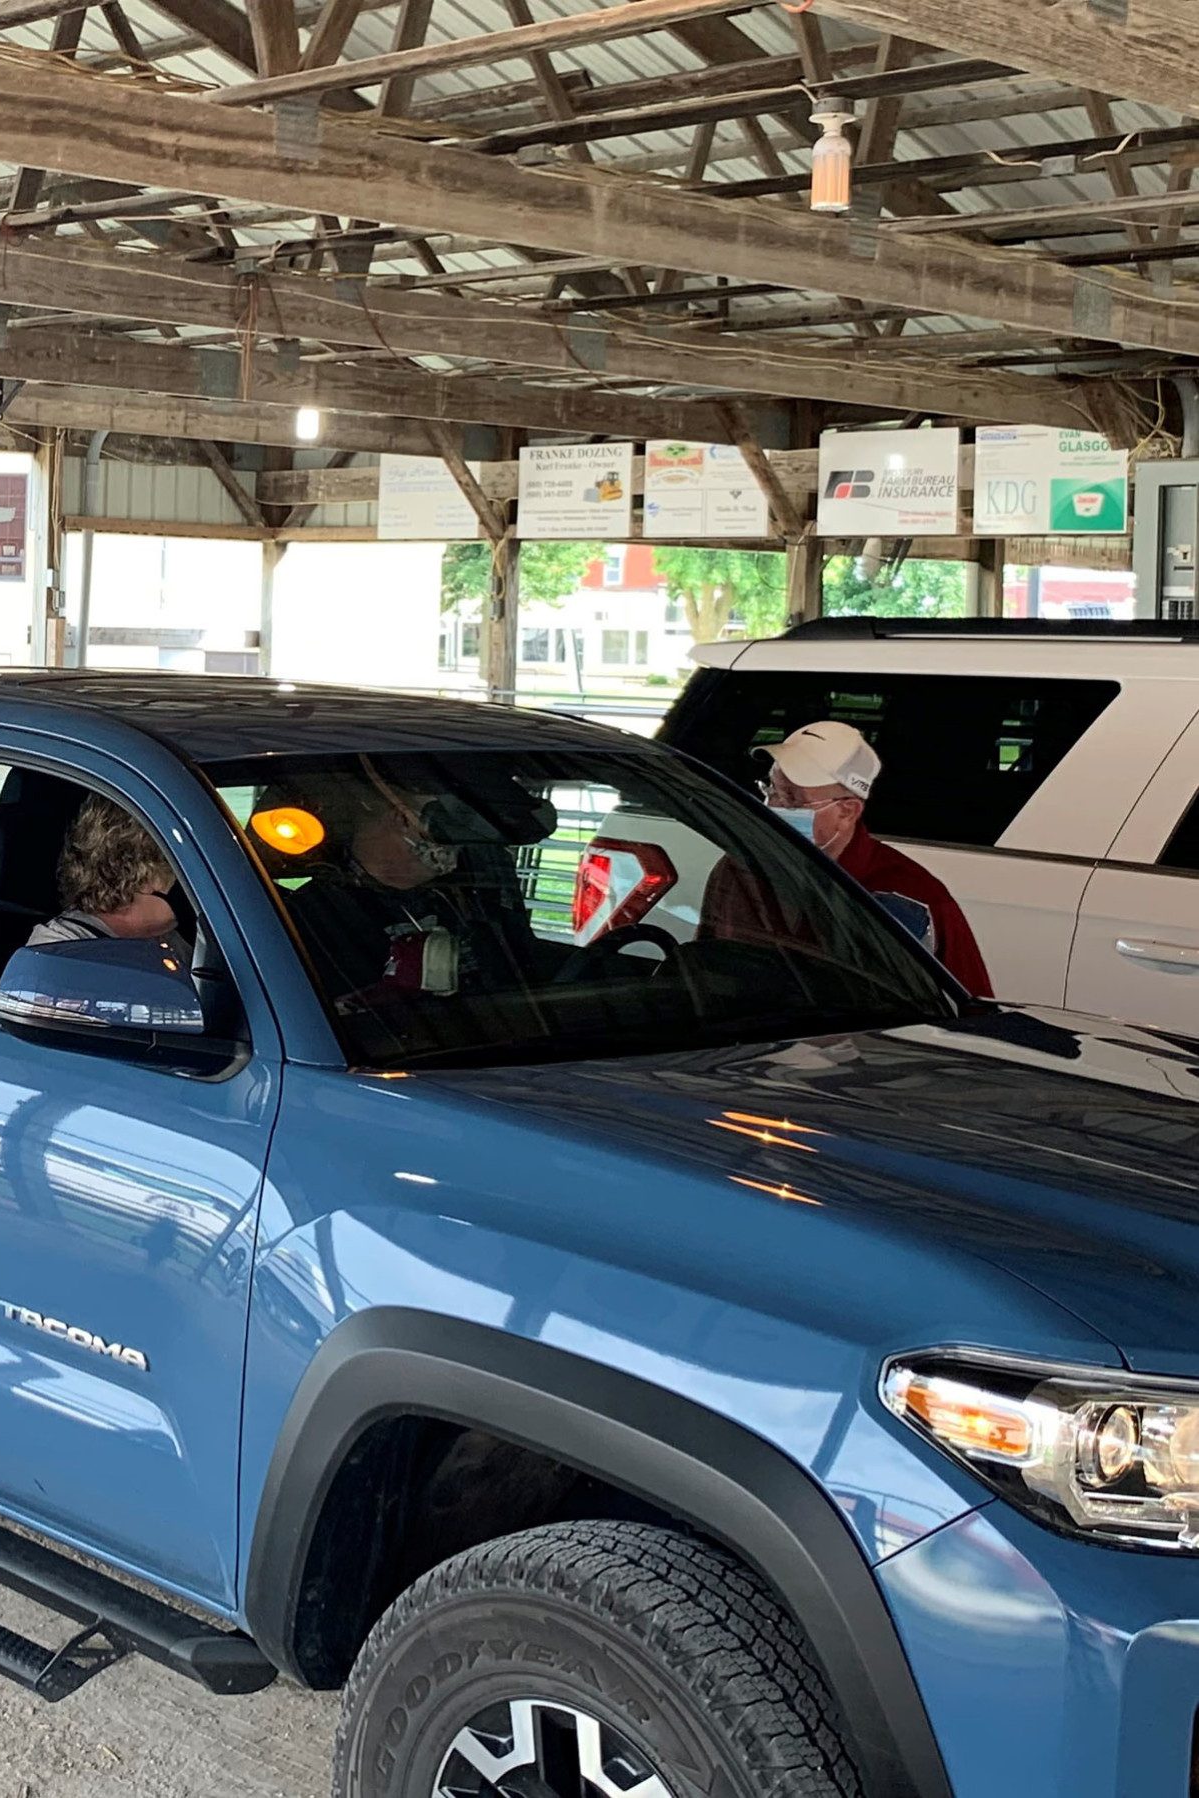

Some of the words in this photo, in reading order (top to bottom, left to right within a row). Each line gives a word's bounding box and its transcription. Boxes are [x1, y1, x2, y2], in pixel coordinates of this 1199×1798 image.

[529, 449, 575, 460] FRANKE
[577, 446, 622, 458] DOZING
[1059, 441, 1110, 453] GLASGO
[881, 476, 910, 486] FARM
[911, 475, 956, 485] BUREAU
[878, 485, 955, 498] INSURANCE
[986, 480, 1037, 515] KDG
